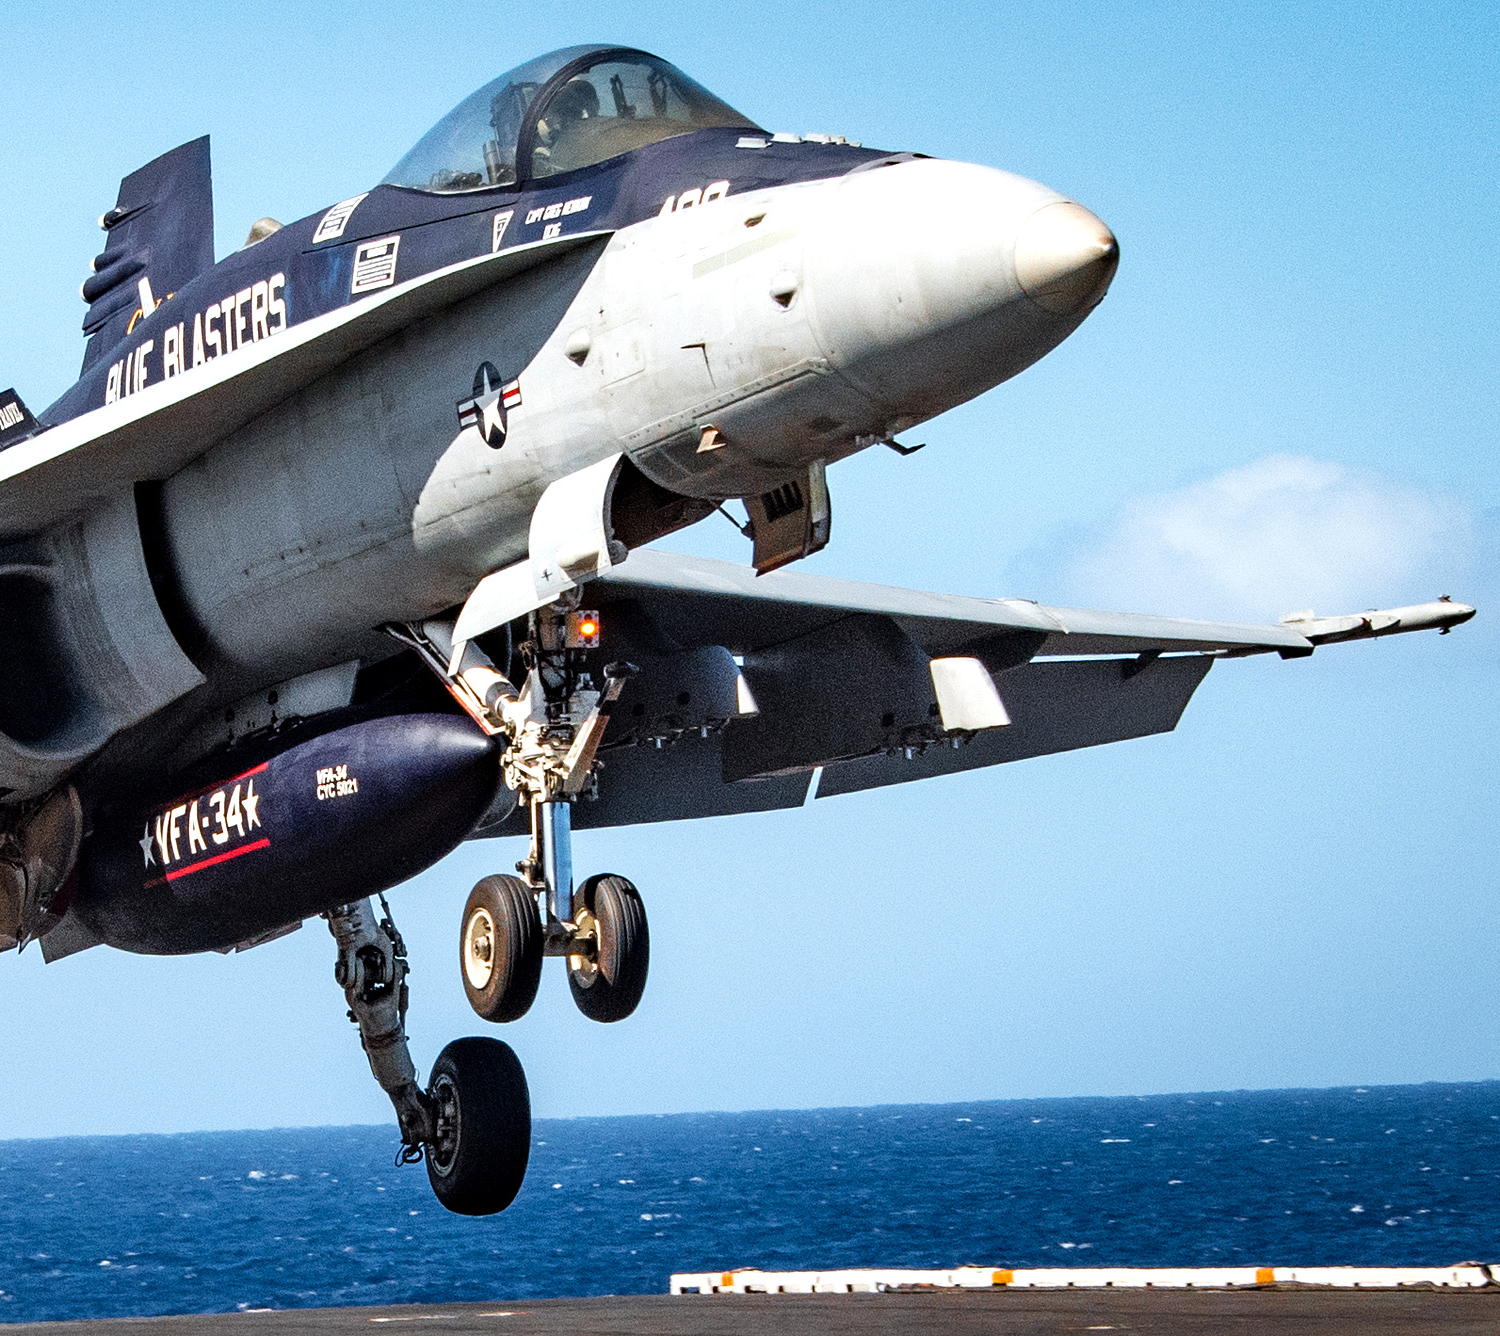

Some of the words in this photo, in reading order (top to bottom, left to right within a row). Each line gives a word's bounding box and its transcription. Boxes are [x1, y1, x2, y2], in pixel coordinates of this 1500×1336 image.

[105, 339, 154, 405] BLUE
[164, 272, 288, 381] BLASTERS
[317, 764, 348, 785] VFA-34
[317, 782, 336, 800] CYC
[336, 778, 359, 797] 5021
[155, 784, 246, 865] VFA-34
